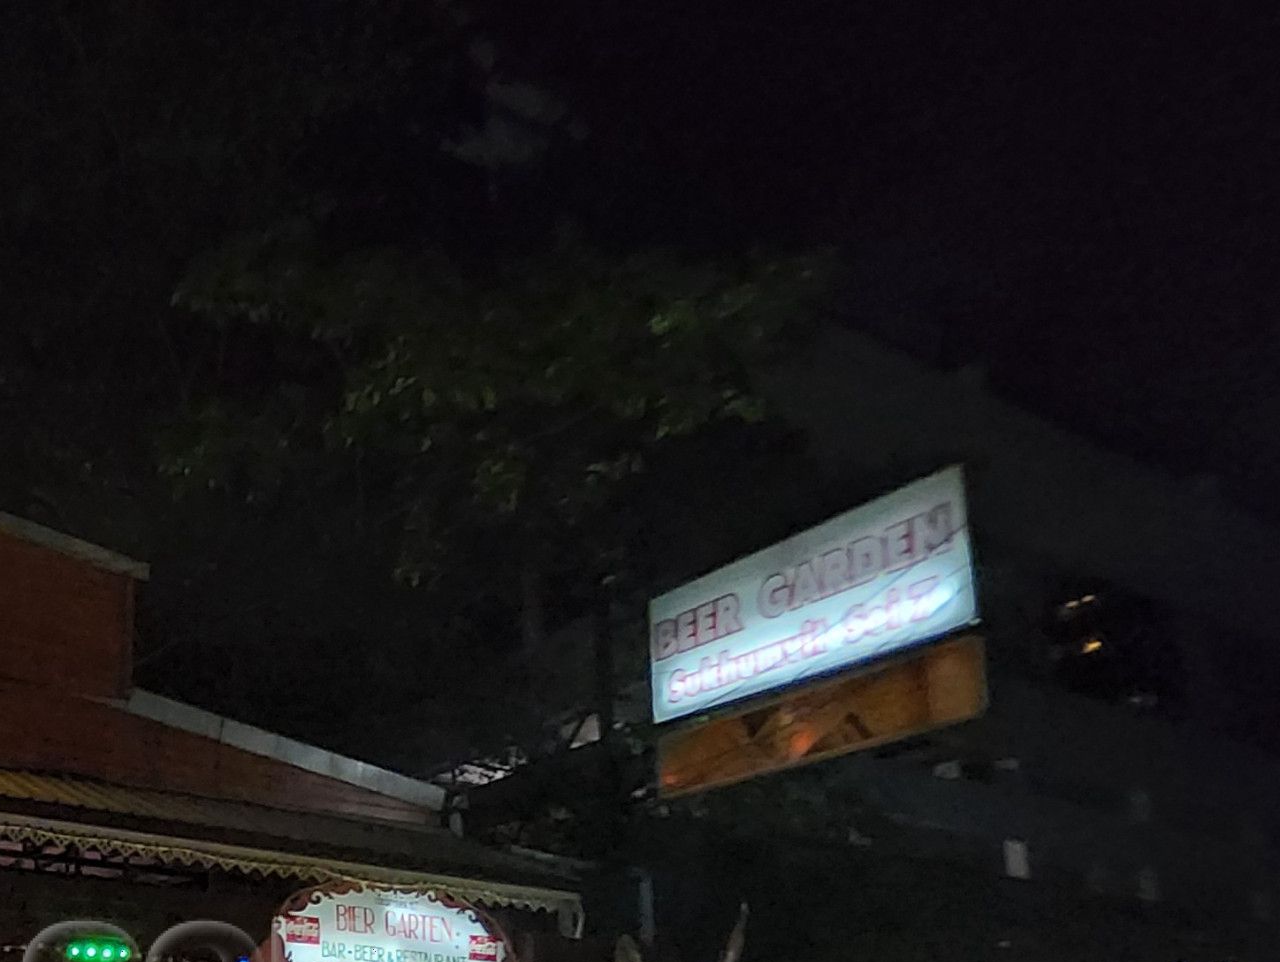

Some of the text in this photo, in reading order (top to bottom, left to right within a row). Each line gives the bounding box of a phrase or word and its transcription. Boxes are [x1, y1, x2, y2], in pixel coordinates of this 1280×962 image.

[654, 500, 954, 662] BEER GARDEN
[335, 904, 375, 935] BIER
